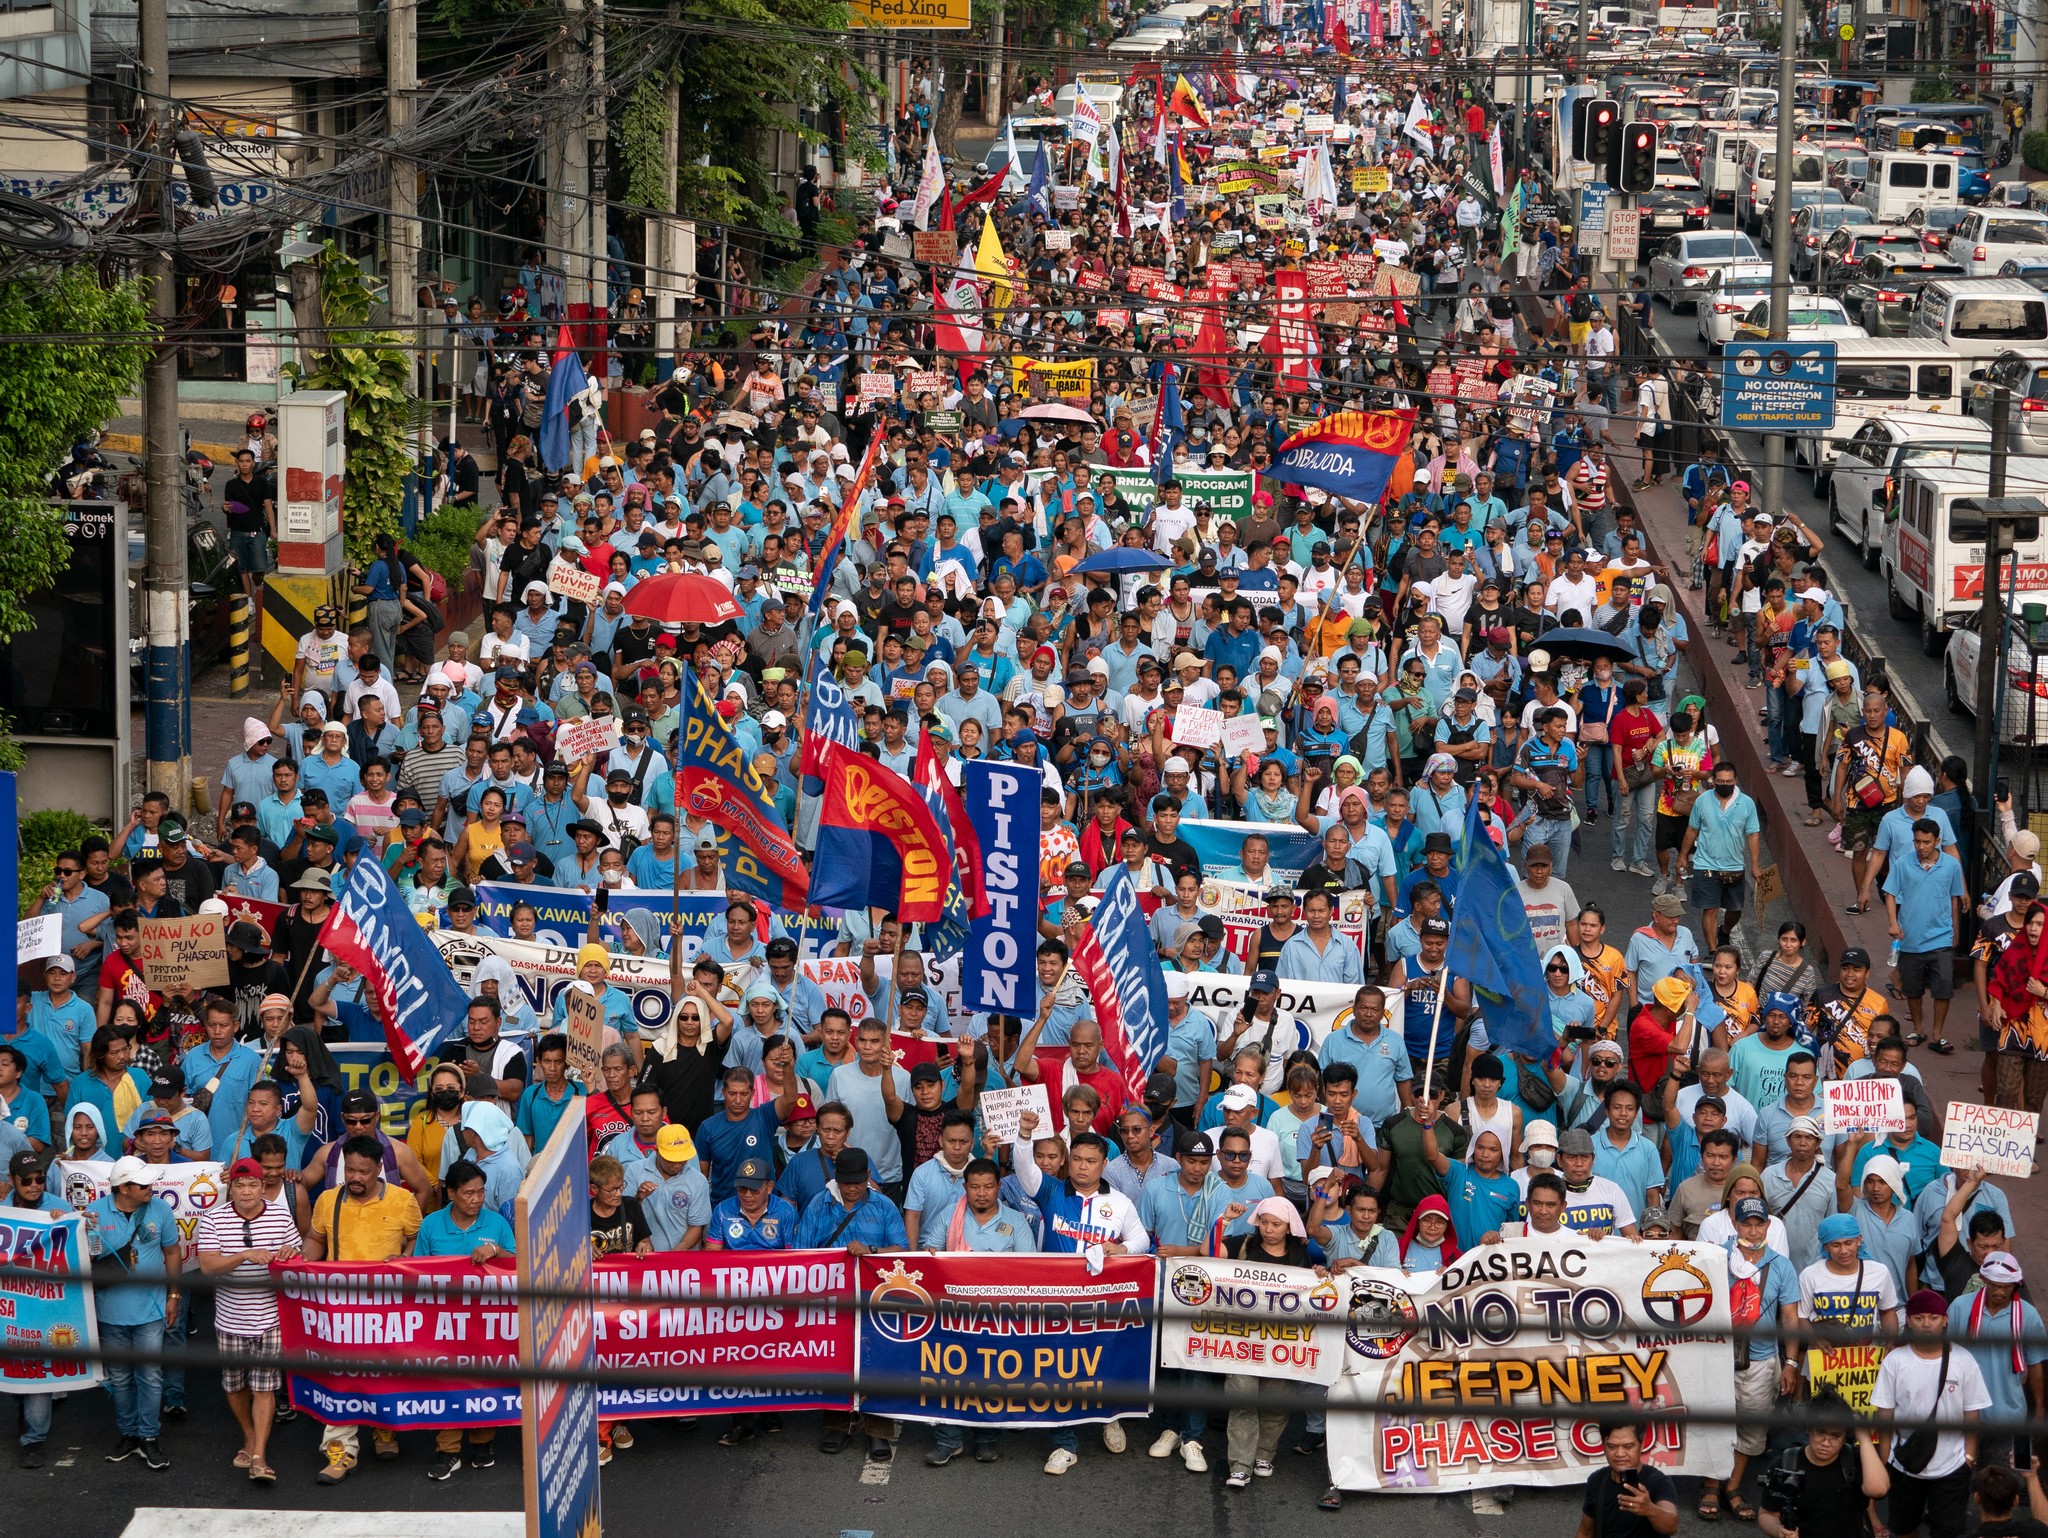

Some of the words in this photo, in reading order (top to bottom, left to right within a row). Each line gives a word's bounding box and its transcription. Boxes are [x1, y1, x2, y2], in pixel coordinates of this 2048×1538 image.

[870, 0, 905, 15] Ped
[908, 0, 947, 18] Xing
[1614, 214, 1637, 222] STOP
[1613, 226, 1636, 234] HERE
[1612, 237, 1620, 245] ON
[1153, 282, 1174, 293] BASTA
[1736, 391, 1822, 400] APPREHENSION
[1745, 382, 1762, 390] NO
[1764, 382, 1813, 390] CONTACT
[1752, 402, 1763, 410] IN
[1766, 402, 1806, 410] EFFECT
[1186, 480, 1248, 490] PROGRAM!
[552, 573, 596, 592] PUVMP
[556, 566, 572, 575] NO
[577, 570, 592, 580] TO
[720, 800, 799, 873] MANIBELA
[860, 789, 939, 903] PISTON
[980, 771, 1020, 1010] PISTON
[142, 925, 181, 941] AYAW
[190, 922, 215, 938] KO
[142, 945, 163, 960] SA
[171, 939, 198, 952] PUV
[177, 949, 227, 963] PHASEOUT
[511, 959, 576, 976] DASMARIÑAS
[153, 975, 187, 983] PISTON
[570, 996, 583, 1013] NO
[585, 1003, 597, 1021] TO
[1425, 1004, 1434, 1015] 21
[572, 1016, 592, 1039] PUV
[340, 1062, 399, 1096] TO
[1021, 1088, 1032, 1097] KA
[1829, 1087, 1841, 1099] NO
[1842, 1084, 1853, 1101] TO
[1855, 1081, 1896, 1102] JEEPNEY
[1037, 1106, 1046, 1114] KA
[1833, 1103, 1861, 1118] PHASE
[1864, 1103, 1887, 1118] OUT!
[1001, 1129, 1018, 1137] TAYO
[1833, 1119, 1851, 1130] SAVE
[1852, 1118, 1869, 1128] OUR
[1570, 1210, 1587, 1223] TO
[1052, 1214, 1115, 1245] MANIBELA
[1233, 1267, 1287, 1284] DASBAC
[1442, 1249, 1587, 1291] DASBAC
[282, 1271, 403, 1305] SINGILIN
[414, 1274, 451, 1305] AT
[641, 1268, 700, 1300] ANG
[712, 1261, 846, 1298] TRAYDOR
[946, 1285, 1029, 1296] TRANSPORTASYON.
[1030, 1285, 1084, 1296] KABUHAYAN.
[1085, 1281, 1139, 1294] KAUNLARAN.
[1215, 1285, 1257, 1310] NO
[1264, 1290, 1302, 1314] TO
[1814, 1296, 1829, 1309] NO
[1833, 1296, 1850, 1309] TO
[302, 1306, 424, 1344] PAHIRAP
[434, 1311, 471, 1341] AT
[619, 1312, 648, 1339] SI
[660, 1302, 784, 1338] MARCOS
[795, 1296, 838, 1329] JR!
[940, 1297, 1145, 1337] MANIBELA
[1191, 1309, 1317, 1342] JEEPNEY
[1424, 1291, 1520, 1350] NO
[1532, 1287, 1624, 1343] TO
[20, 1328, 43, 1339] ROSA
[1636, 1330, 1727, 1350] MANIBELA
[713, 1340, 836, 1366] PROGRAM!
[920, 1341, 968, 1376] NO
[976, 1346, 1023, 1380] TO
[1034, 1346, 1103, 1380] PUV
[1187, 1336, 1265, 1363] PHASE
[1271, 1343, 1320, 1369] OUT
[1823, 1348, 1876, 1371] IBALIK
[1385, 1350, 1667, 1406] JEEPNEY
[313, 1389, 377, 1415] PISTON
[397, 1400, 445, 1416] KMU
[466, 1396, 497, 1414] NO
[596, 1385, 700, 1405] PHASEOUT
[1382, 1417, 1559, 1474] PHASE
